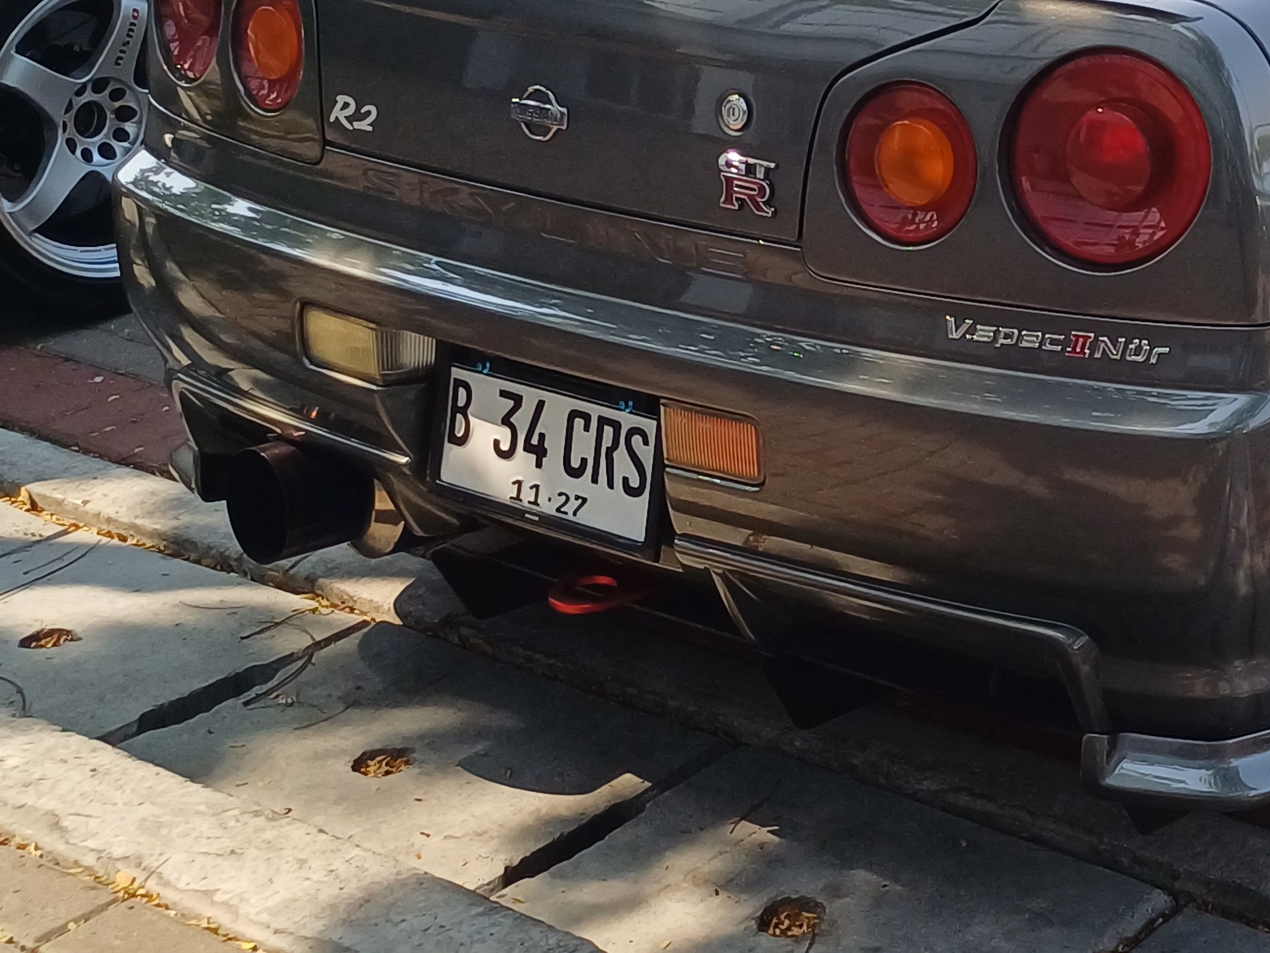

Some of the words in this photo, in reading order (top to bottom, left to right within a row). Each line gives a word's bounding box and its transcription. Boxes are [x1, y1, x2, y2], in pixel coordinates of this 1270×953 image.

[329, 94, 378, 132] R2
[447, 376, 473, 448] B
[493, 388, 548, 469] 34
[562, 408, 650, 498] CRS
